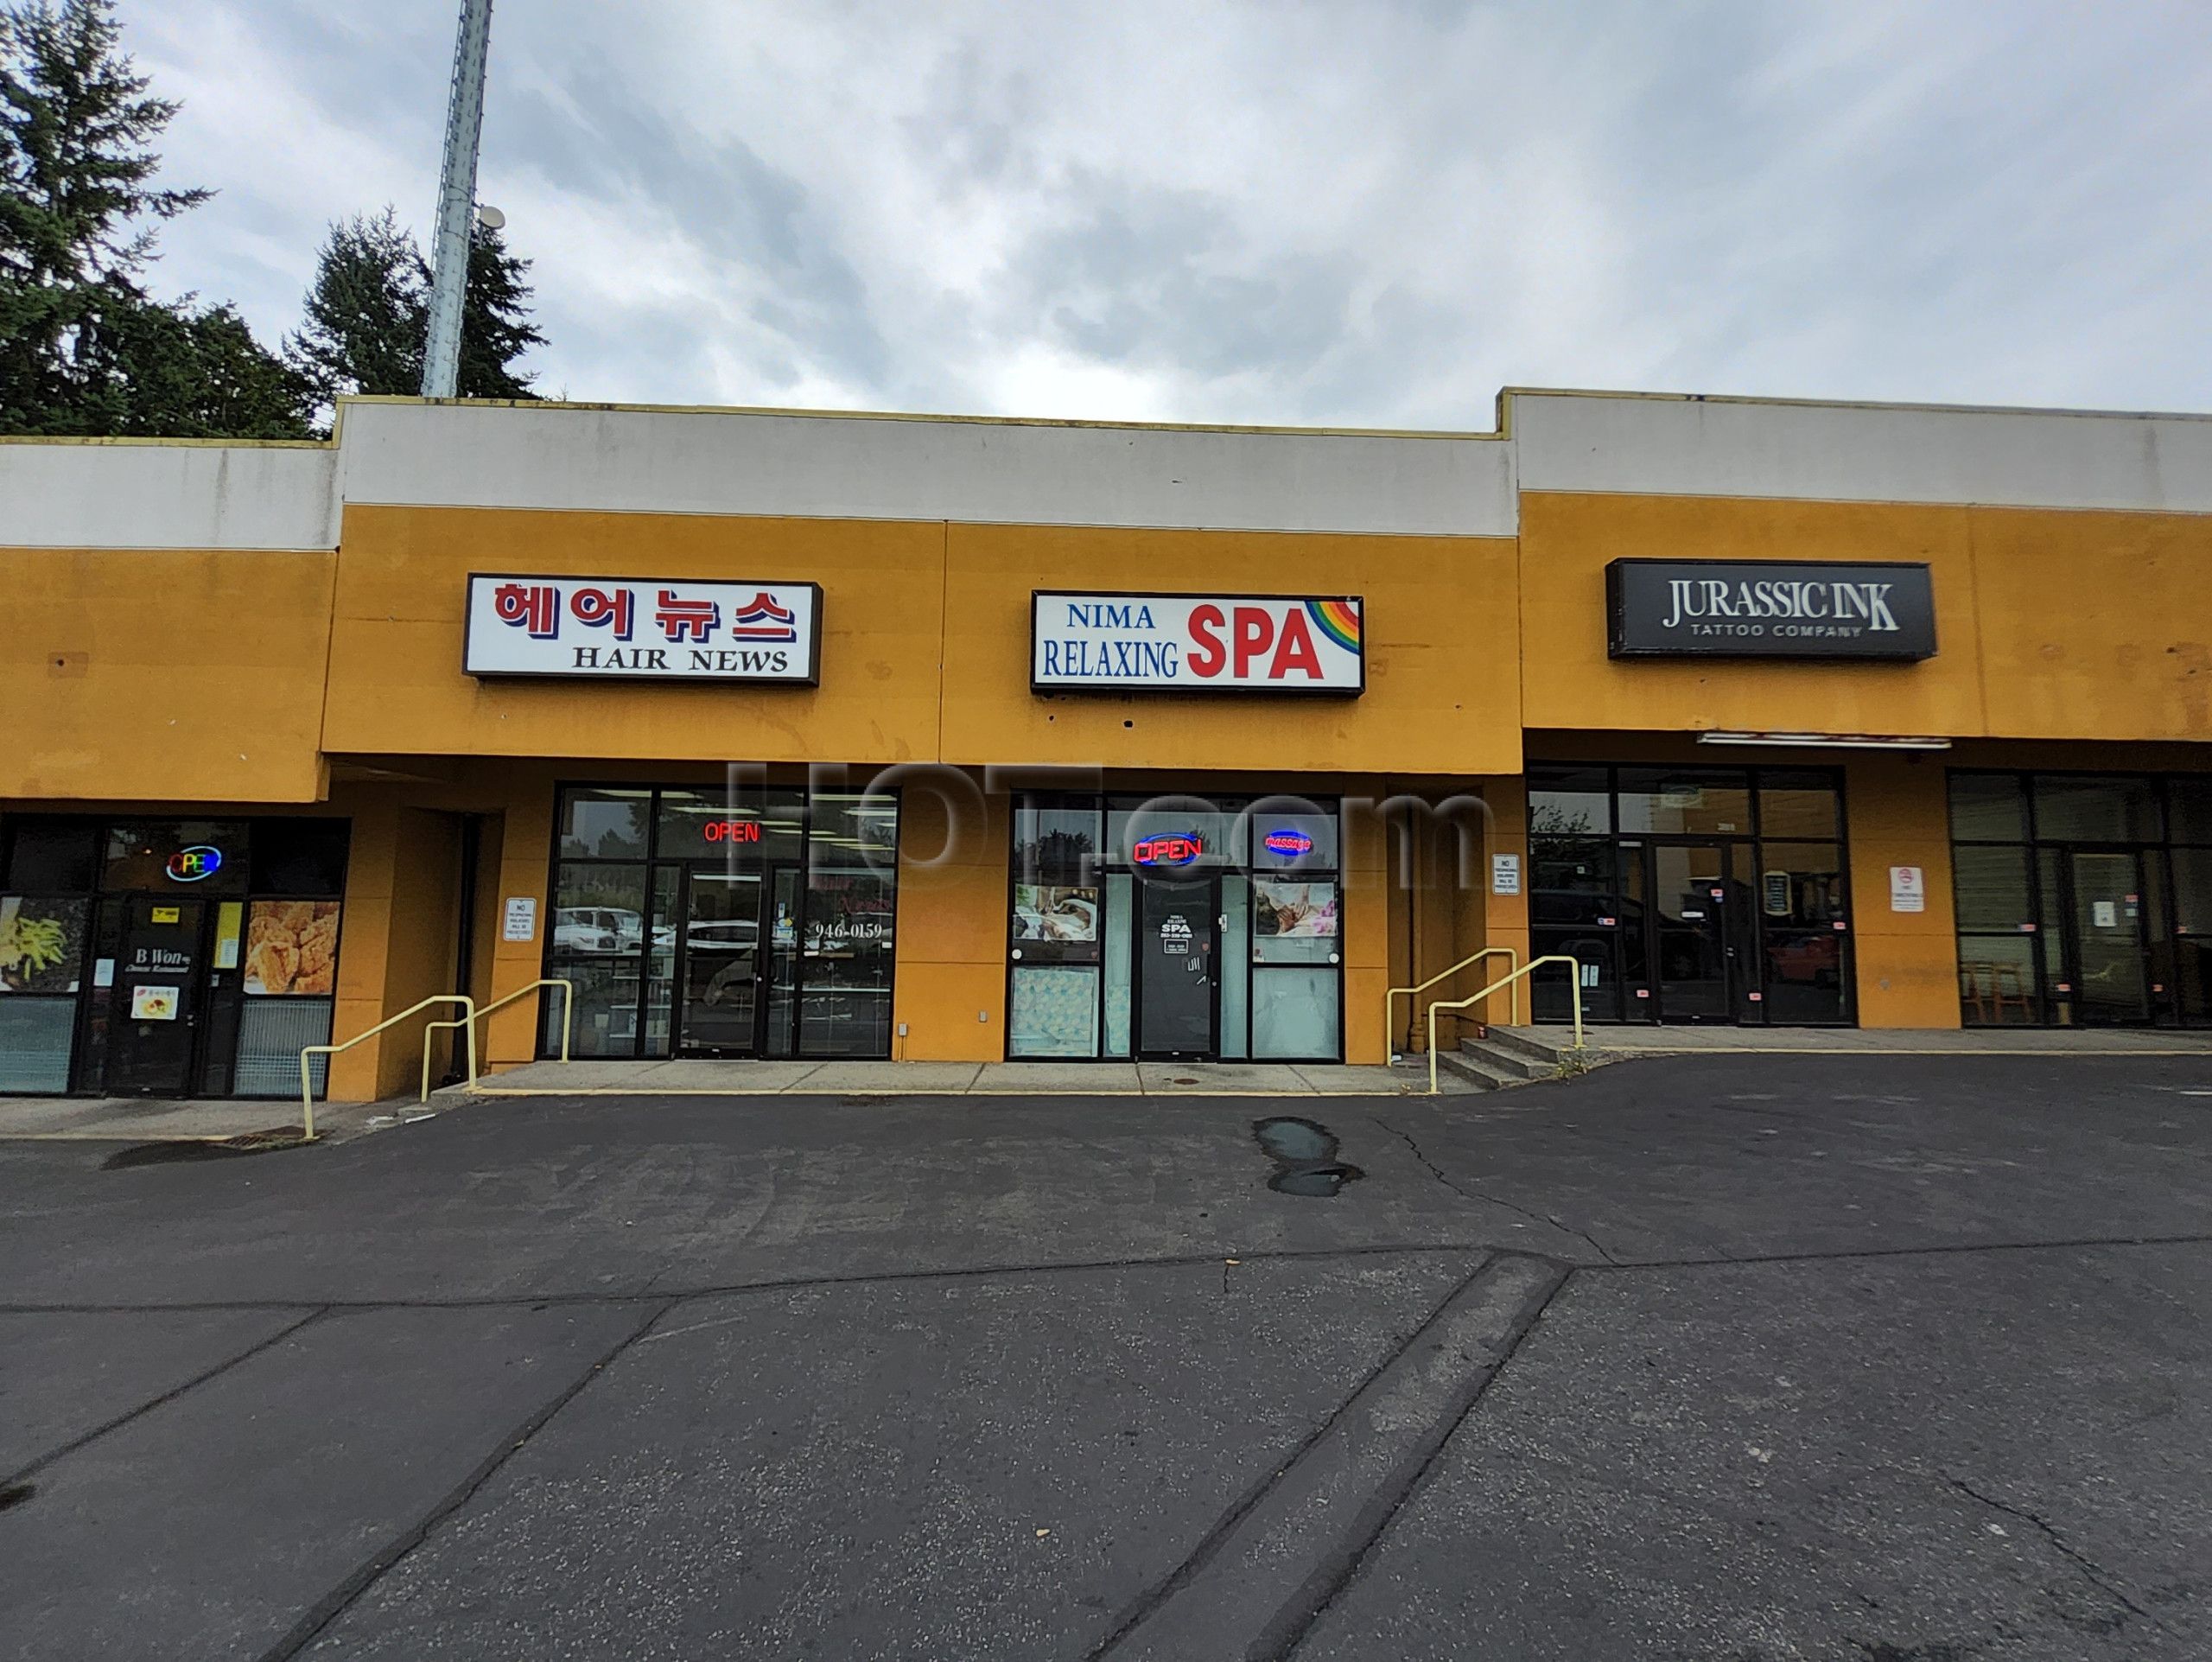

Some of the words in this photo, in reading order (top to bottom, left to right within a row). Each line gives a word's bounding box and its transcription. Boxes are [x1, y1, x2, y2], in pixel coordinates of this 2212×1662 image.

[494, 583, 797, 644] 헤어뉴스
[1066, 603, 1156, 629] NIMA
[1662, 580, 1828, 628] JURASSIC
[1830, 583, 1900, 632] INK
[1186, 603, 1324, 679] SPA
[1691, 623, 1764, 637] TATTOO
[1771, 624, 1863, 638] COMPANY
[571, 646, 671, 670] HAIR
[688, 650, 788, 673] NEWS
[1043, 640, 1179, 678] RELAXING
[703, 820, 761, 844] OPEN
[1133, 838, 1203, 863] OPEN
[815, 923, 882, 939] 946-0159
[1161, 924, 1192, 933] SPA
[136, 948, 148, 964] B
